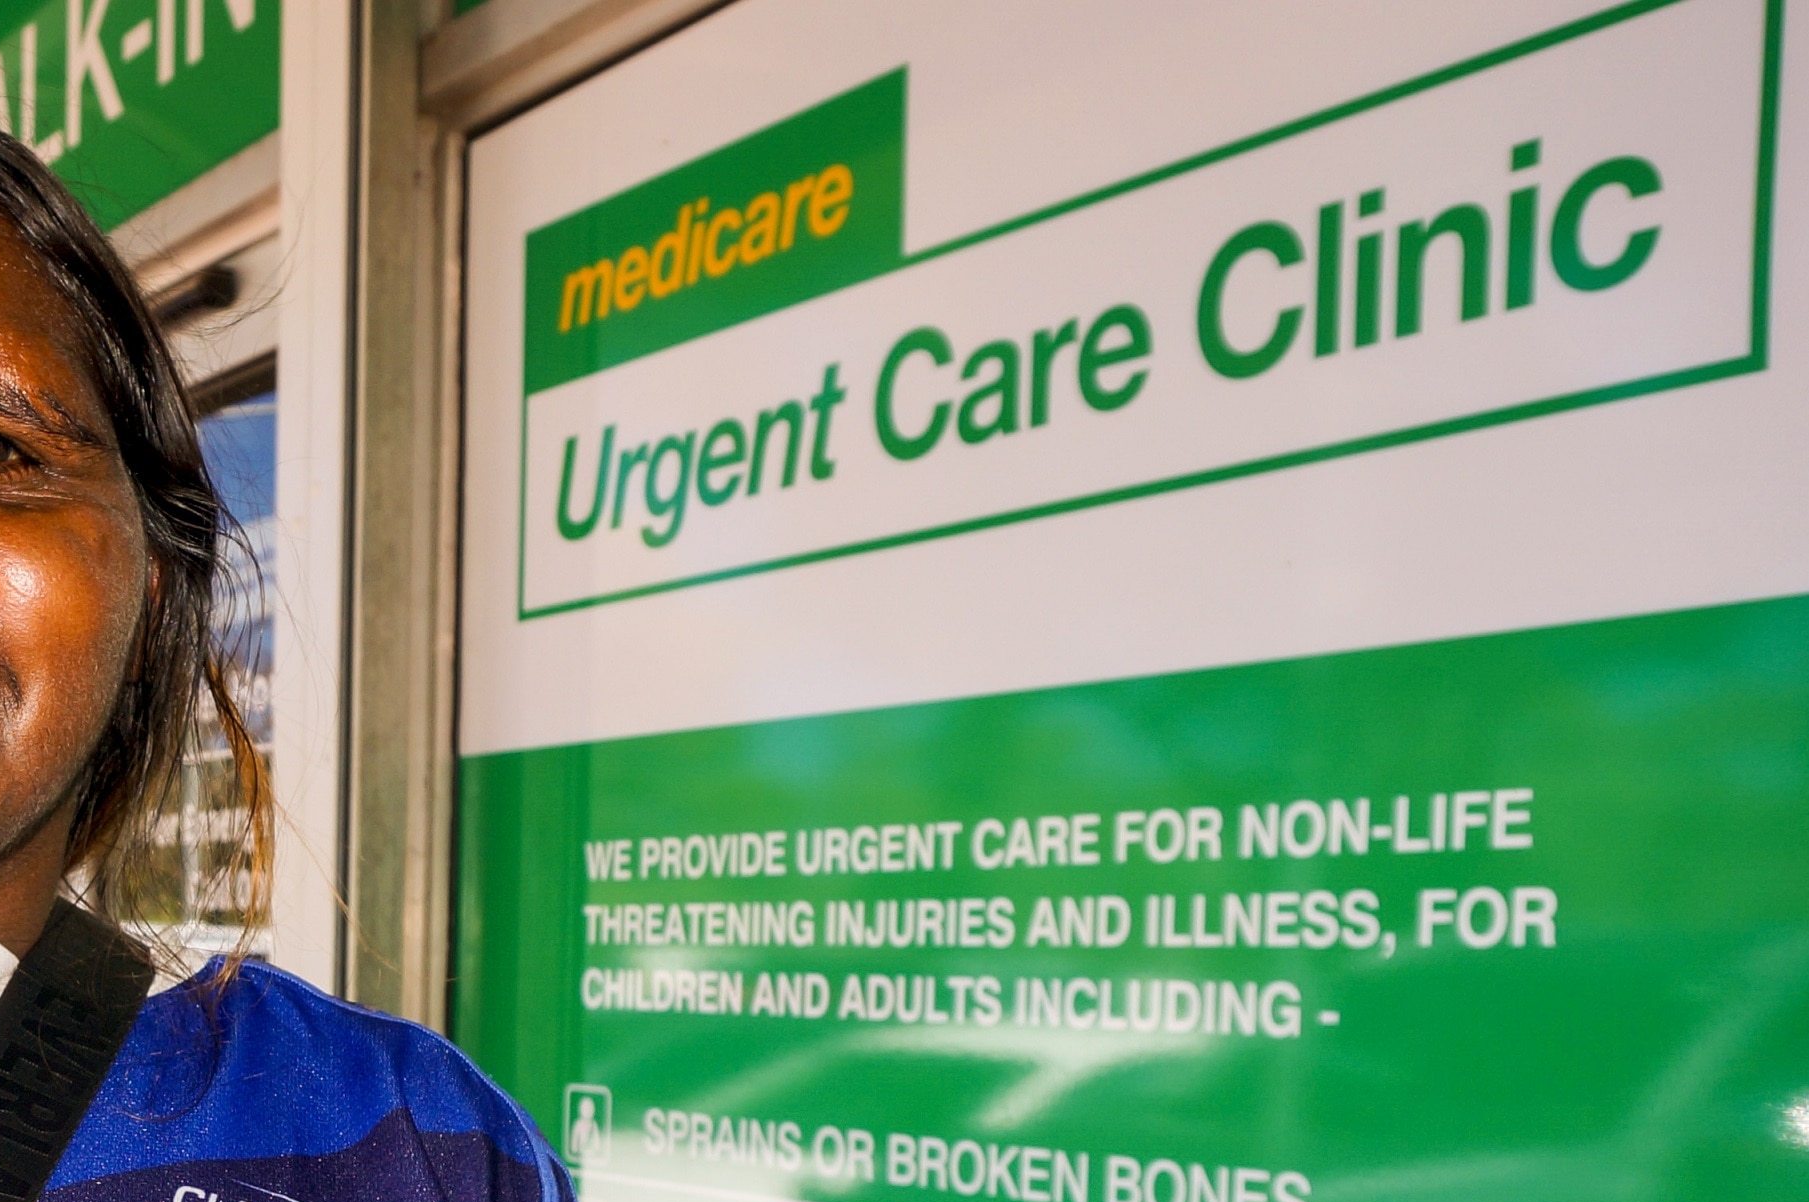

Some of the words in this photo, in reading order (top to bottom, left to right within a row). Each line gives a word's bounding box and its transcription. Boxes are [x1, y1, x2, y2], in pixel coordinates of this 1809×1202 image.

[556, 162, 854, 334] medicare
[554, 363, 847, 550] Urgent
[871, 303, 1153, 463] Care
[1196, 137, 1664, 380] Clinic
[586, 841, 632, 881] WE
[640, 832, 786, 879] PROVIDE
[796, 823, 962, 877] URGENT
[971, 815, 1100, 871] CARE
[1114, 807, 1222, 866] FOR
[1238, 788, 1534, 860] NON-LIFE
[583, 902, 814, 948] THREATENING
[825, 897, 1015, 949] INJURIES
[1026, 894, 1131, 950] AND
[1145, 890, 1397, 960] ILLNESS,
[1417, 887, 1558, 949] FOR
[581, 967, 744, 1015] CHILDREN
[752, 973, 829, 1018] AND
[839, 974, 1003, 1026] ADULTS
[1014, 977, 1301, 1040] INCLUDING
[642, 1108, 801, 1171] SPRAINS
[814, 1129, 874, 1181] OR
